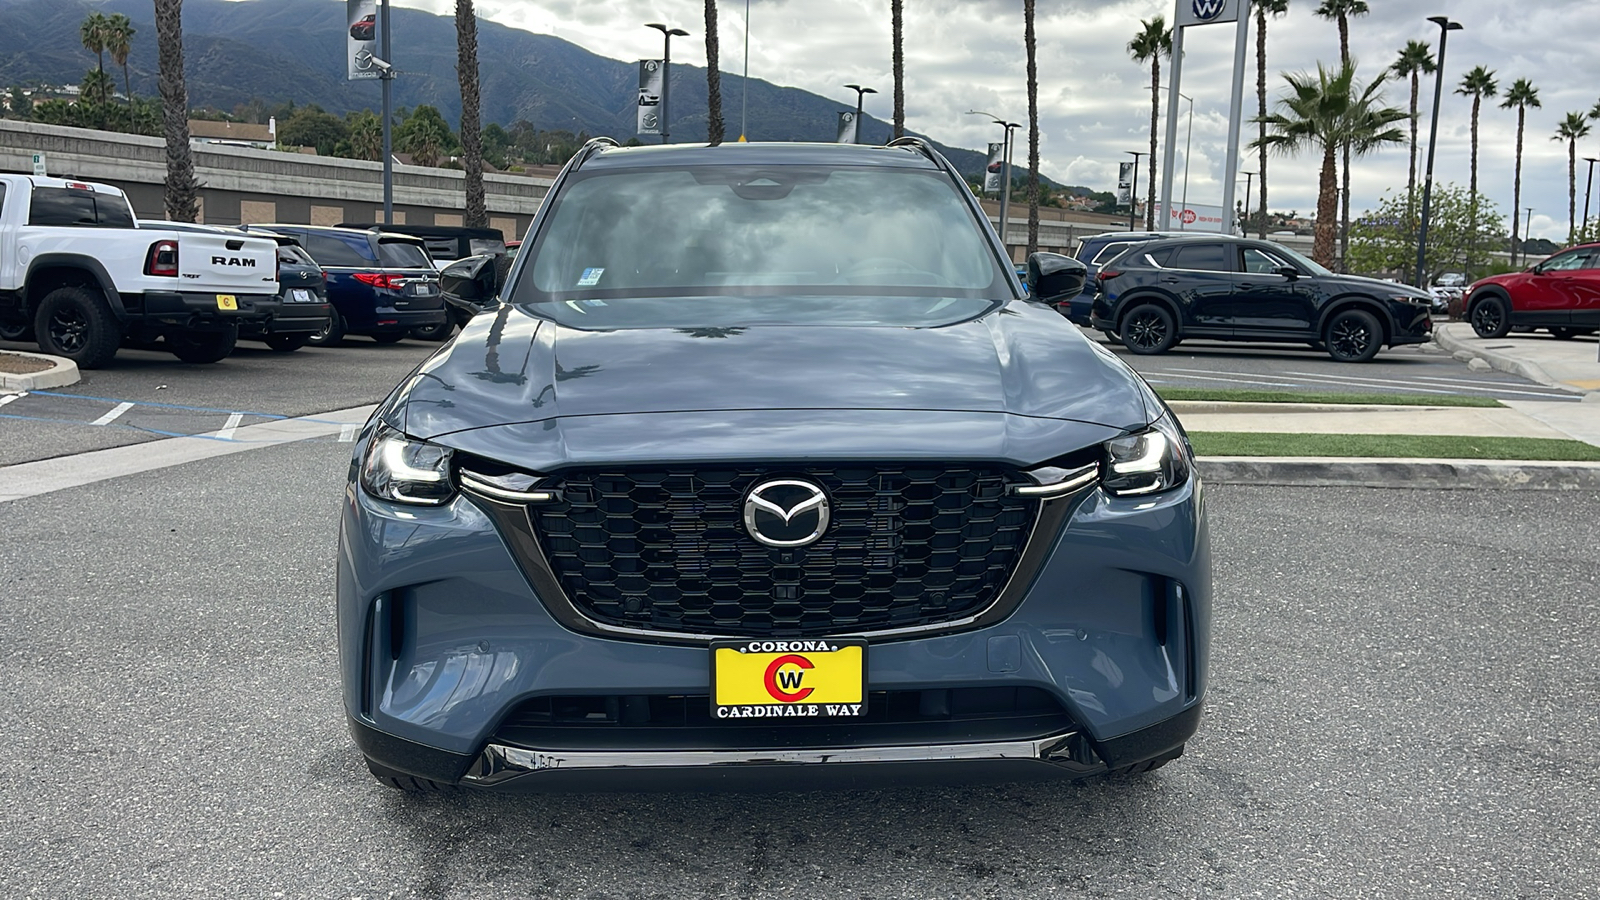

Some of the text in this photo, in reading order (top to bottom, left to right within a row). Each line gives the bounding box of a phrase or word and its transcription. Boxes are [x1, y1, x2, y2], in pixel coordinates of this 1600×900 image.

[211, 256, 256, 267] RAM
[748, 641, 829, 652] CORONA
[717, 704, 862, 718] CARDINALE WAY
